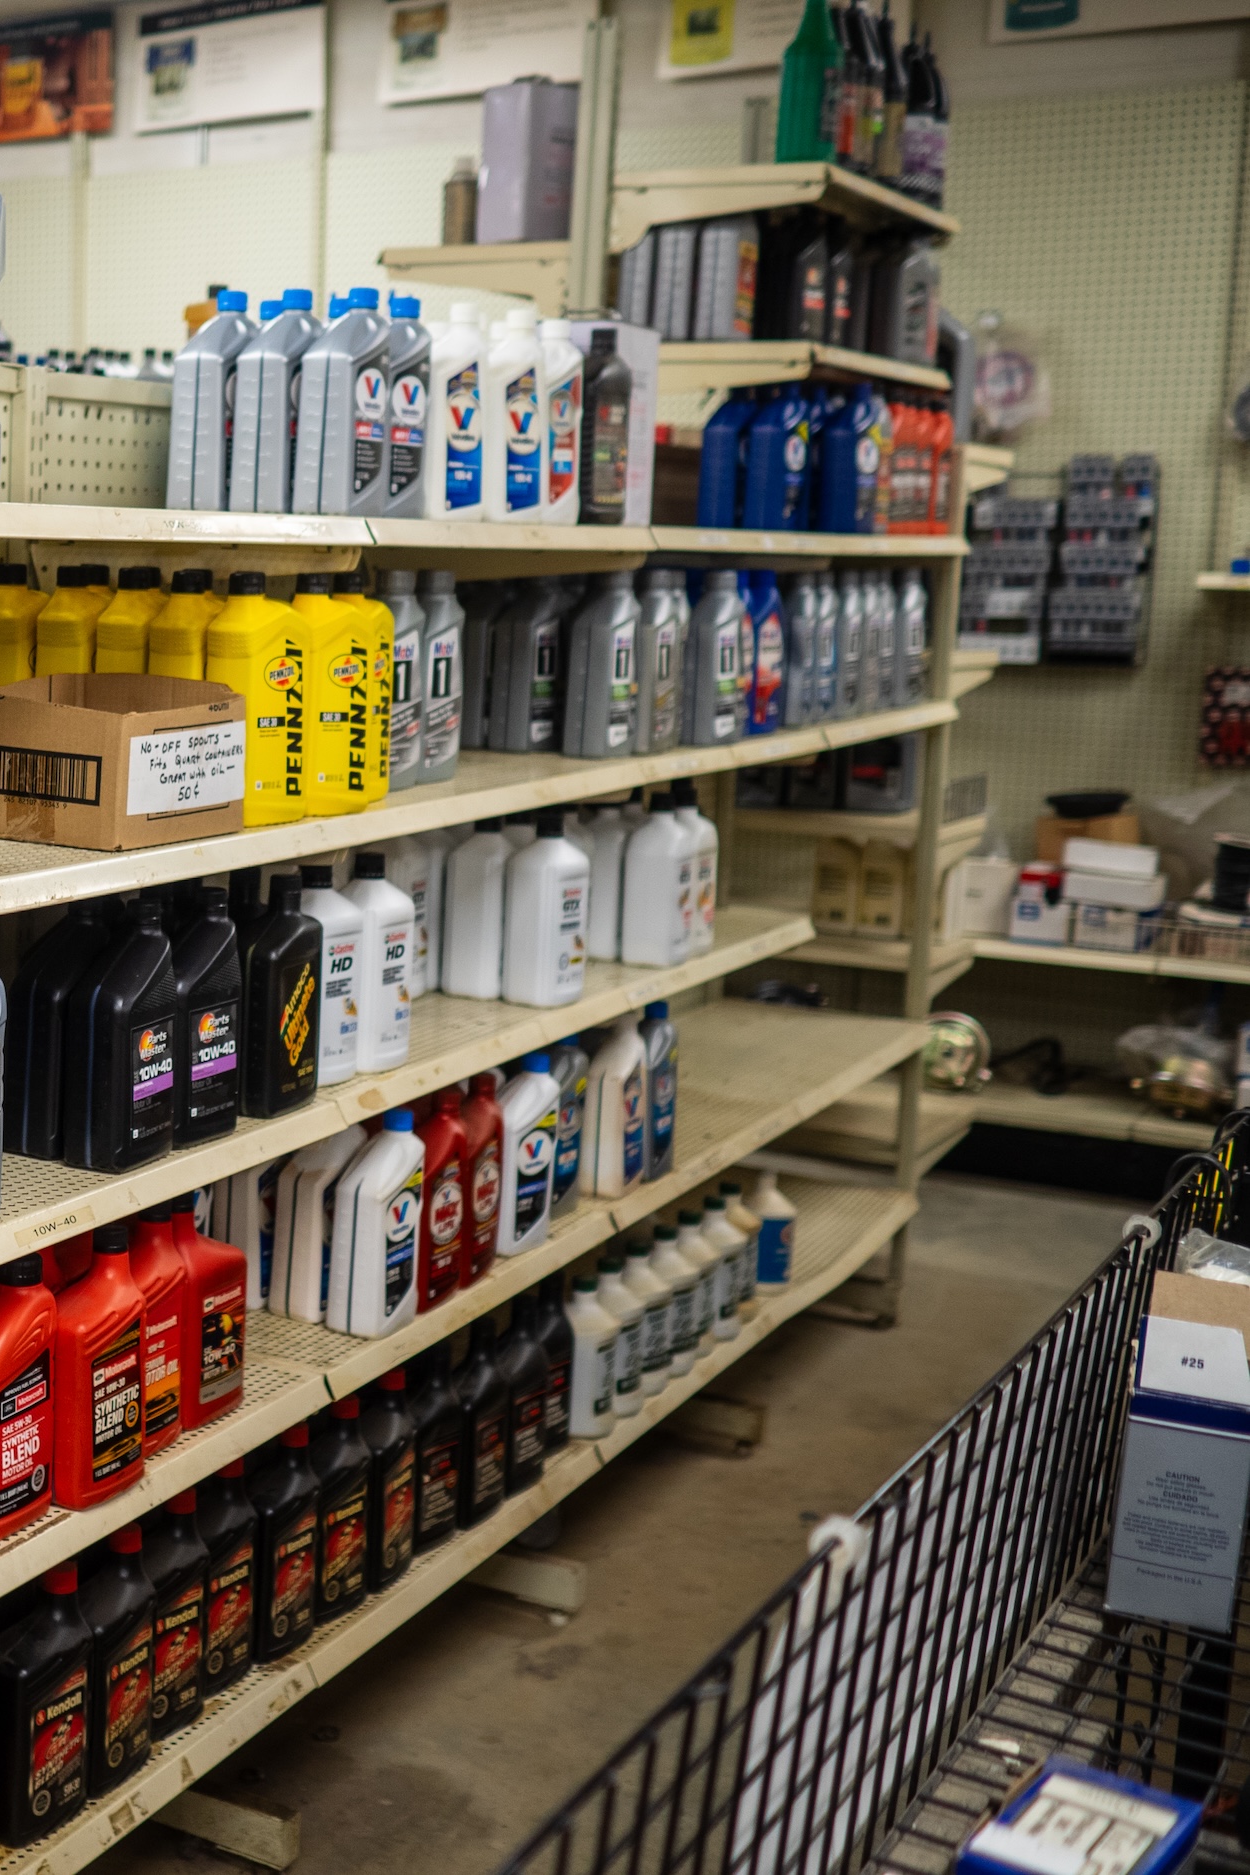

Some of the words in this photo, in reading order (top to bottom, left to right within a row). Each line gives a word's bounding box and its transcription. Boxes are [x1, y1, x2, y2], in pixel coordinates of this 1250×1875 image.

[269, 666, 295, 681] PENNZOIL
[334, 664, 360, 678] PENNZOIL
[438, 660, 446, 696] 1
[397, 663, 406, 701] 1
[386, 944, 405, 961] HD
[330, 957, 353, 974] HD
[285, 963, 311, 1017] Amoco
[208, 1014, 230, 1026] Parts
[148, 1031, 167, 1045] Parts
[200, 1026, 229, 1041] Master
[289, 1014, 310, 1067] Gold
[140, 1043, 166, 1060] Master
[199, 1040, 236, 1062] 10W-40
[139, 1058, 172, 1081] 10W-40
[33, 1214, 77, 1237] 10W-40
[105, 1353, 137, 1380] Motorcraft
[1181, 1356, 1205, 1370] #25
[106, 1377, 127, 1395] 10W-30
[17, 1387, 45, 1407] Motorcraft
[94, 1384, 140, 1420] SYNTHETIC
[2, 1422, 14, 1437] SAE
[14, 1414, 33, 1431] 5W-30
[95, 1406, 125, 1434] BLEND
[2, 1424, 40, 1450] SYNTHETIC
[95, 1428, 114, 1445] MOTOR
[2, 1436, 41, 1469] BLEND
[2, 1463, 25, 1480] MOTOR
[25, 1459, 34, 1471] OIL
[1165, 1471, 1200, 1483] CAUTION
[1163, 1490, 1198, 1503] CUIDADO
[165, 1606, 199, 1631] Kendall
[47, 1691, 83, 1721] Kendall
